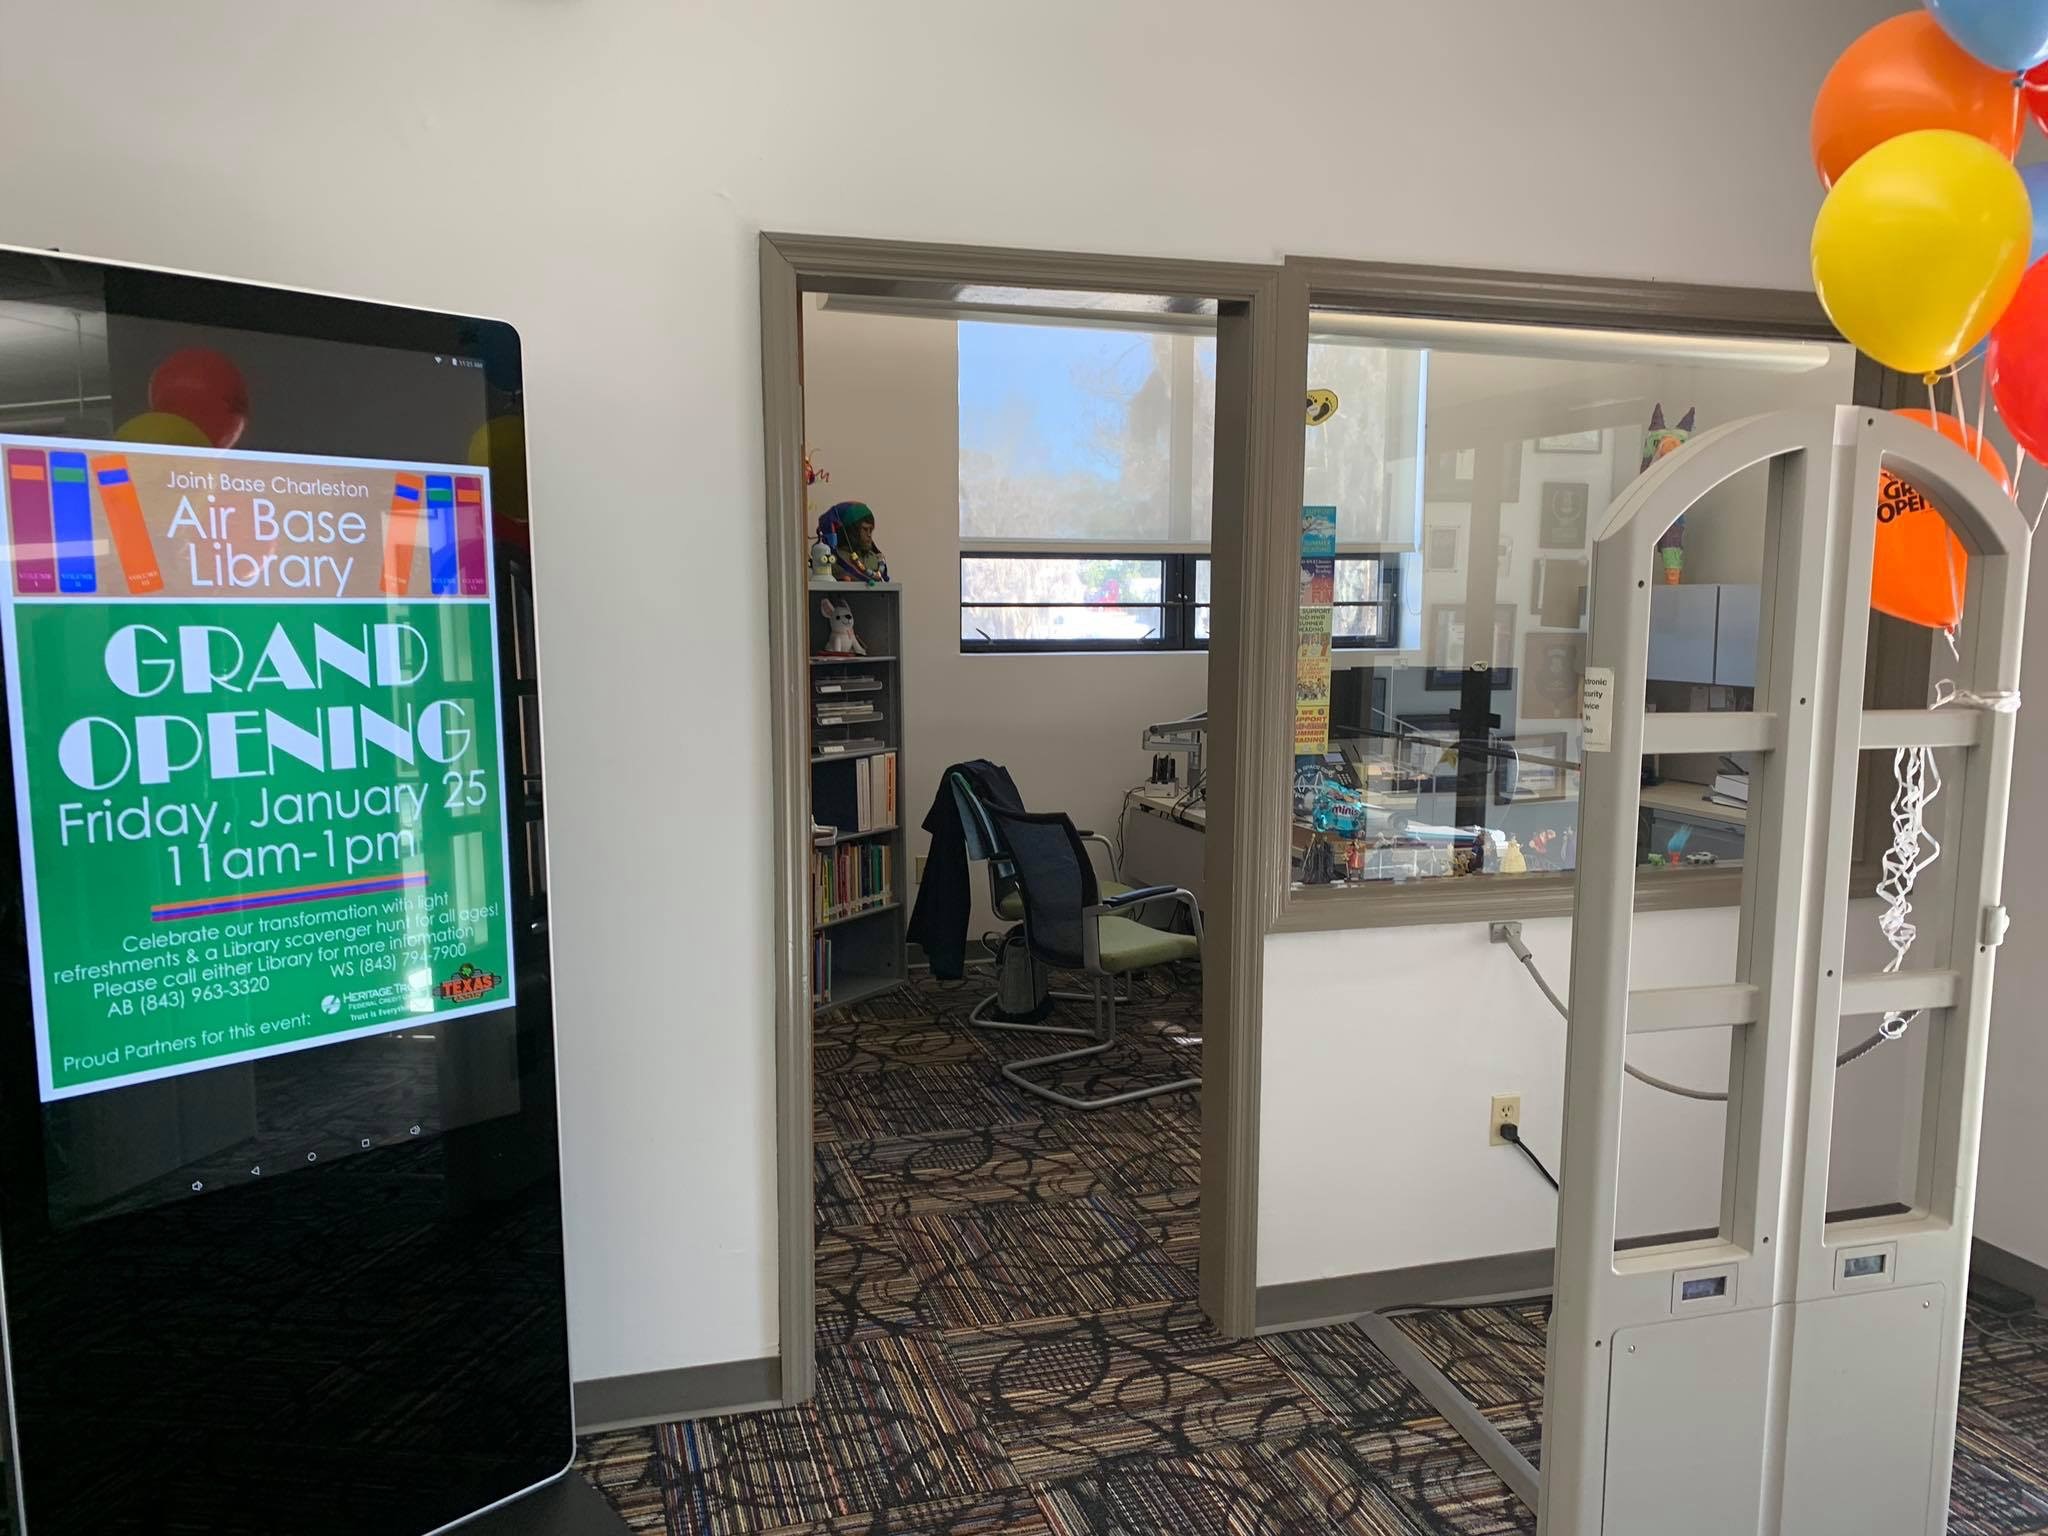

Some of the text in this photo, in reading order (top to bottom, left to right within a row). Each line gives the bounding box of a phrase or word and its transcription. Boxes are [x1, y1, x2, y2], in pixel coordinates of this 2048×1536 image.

[167, 471, 369, 498] Joint Base Charleston
[1883, 480, 1914, 499] GR
[166, 494, 367, 545] Air Base
[188, 541, 354, 598] Library
[104, 621, 429, 698] GRAND
[1584, 691, 1603, 699] curity
[58, 699, 472, 791] OPENING
[59, 769, 488, 847] Friday, January 25
[167, 828, 416, 887] 11am-1pm
[53, 902, 499, 985] refreshments & a Library scavenger hunt for all ages!
[122, 892, 449, 953] Celebrate our transformation with light
[93, 924, 474, 999] Please call either Library for more information
[330, 942, 467, 978] WS (843) 794-7900
[442, 975, 493, 995] TEXAS
[107, 975, 270, 1018] AB (843) 963-3320
[342, 986, 393, 1004] HERITAGE
[350, 1011, 369, 1021] Trust
[64, 1013, 311, 1072] Proud Partners for this event:
